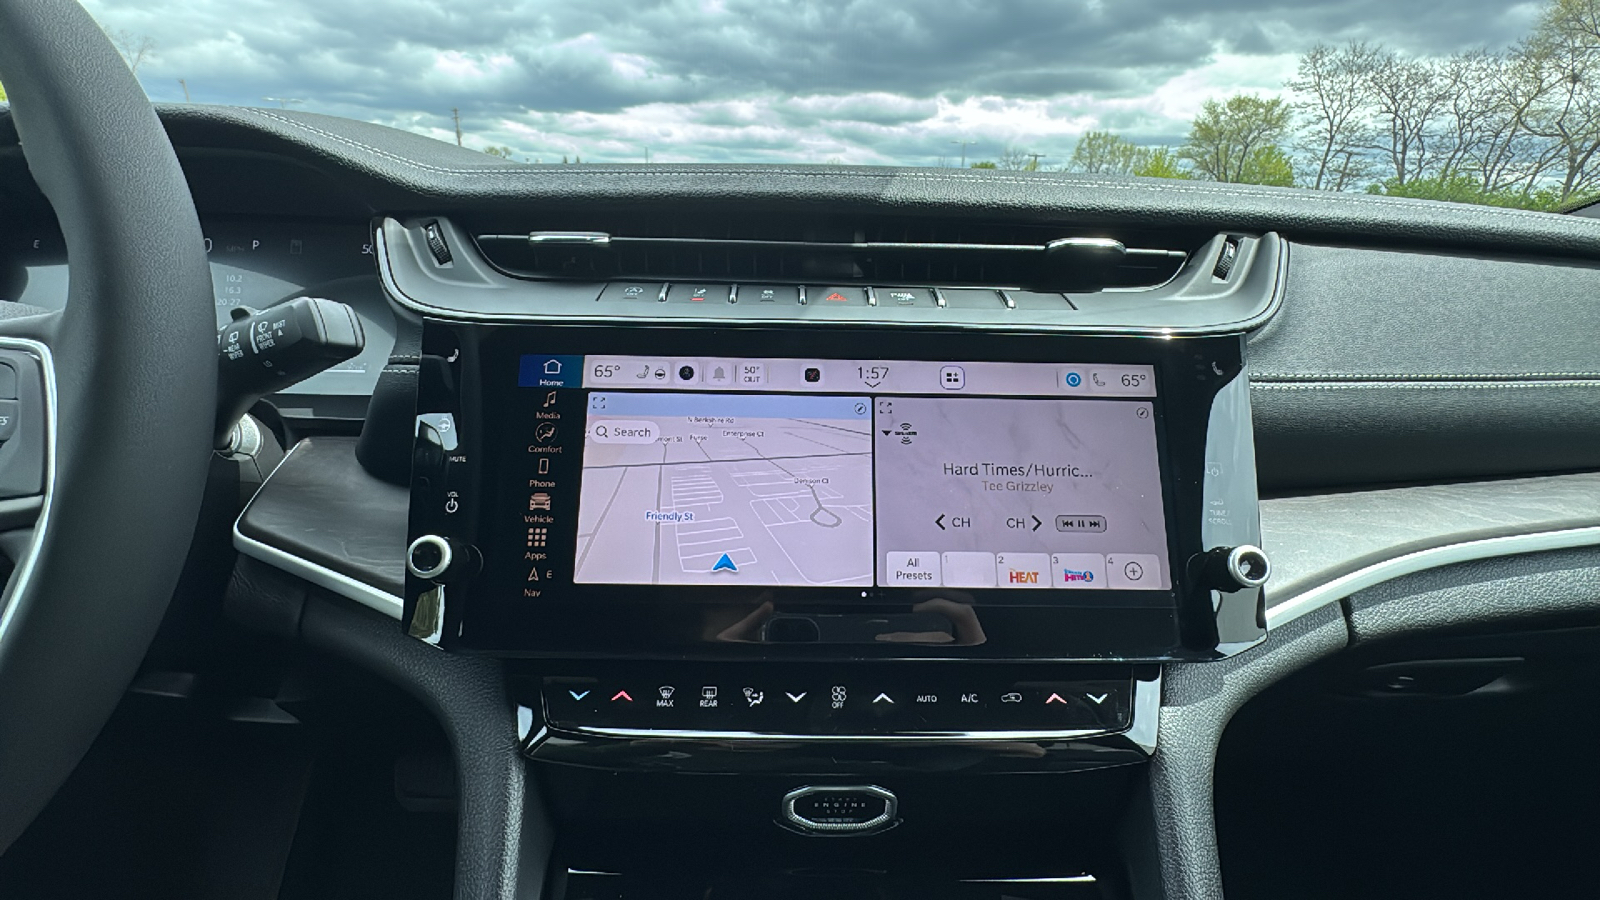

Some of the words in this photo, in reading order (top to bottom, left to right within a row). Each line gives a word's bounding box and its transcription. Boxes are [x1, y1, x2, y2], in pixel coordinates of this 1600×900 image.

[252, 239, 260, 251] P
[226, 274, 243, 283] 10.2
[594, 364, 621, 379] 65°
[857, 366, 889, 379] 1:57
[539, 379, 564, 387] Home
[1121, 373, 1147, 388] 65°
[536, 412, 561, 420] Media
[613, 427, 651, 438] Search
[722, 430, 756, 438] Enterprise
[527, 445, 563, 454] Comfort
[448, 455, 467, 463] MUTE
[943, 462, 979, 476] Hard
[529, 479, 556, 488] Phone
[981, 480, 1004, 491] Tee
[1005, 481, 1054, 493] Grizzley
[524, 515, 554, 523] Vehicle
[645, 510, 684, 522] Friendly
[684, 511, 694, 521] St
[951, 516, 971, 528] CH
[1006, 517, 1026, 529] CH
[524, 551, 547, 561] Apps
[998, 555, 1005, 564] 2
[1052, 556, 1060, 565] 3
[906, 557, 921, 568] All
[1107, 557, 1115, 566] 4
[546, 570, 553, 579] E
[896, 570, 933, 581] Presets
[1009, 571, 1039, 584] HEAT
[523, 588, 541, 598] Nav
[656, 699, 674, 708] MAX
[699, 699, 718, 708] REAR
[916, 694, 938, 704] AUTO
[960, 693, 979, 704] A/C
[831, 701, 844, 709] OFF
